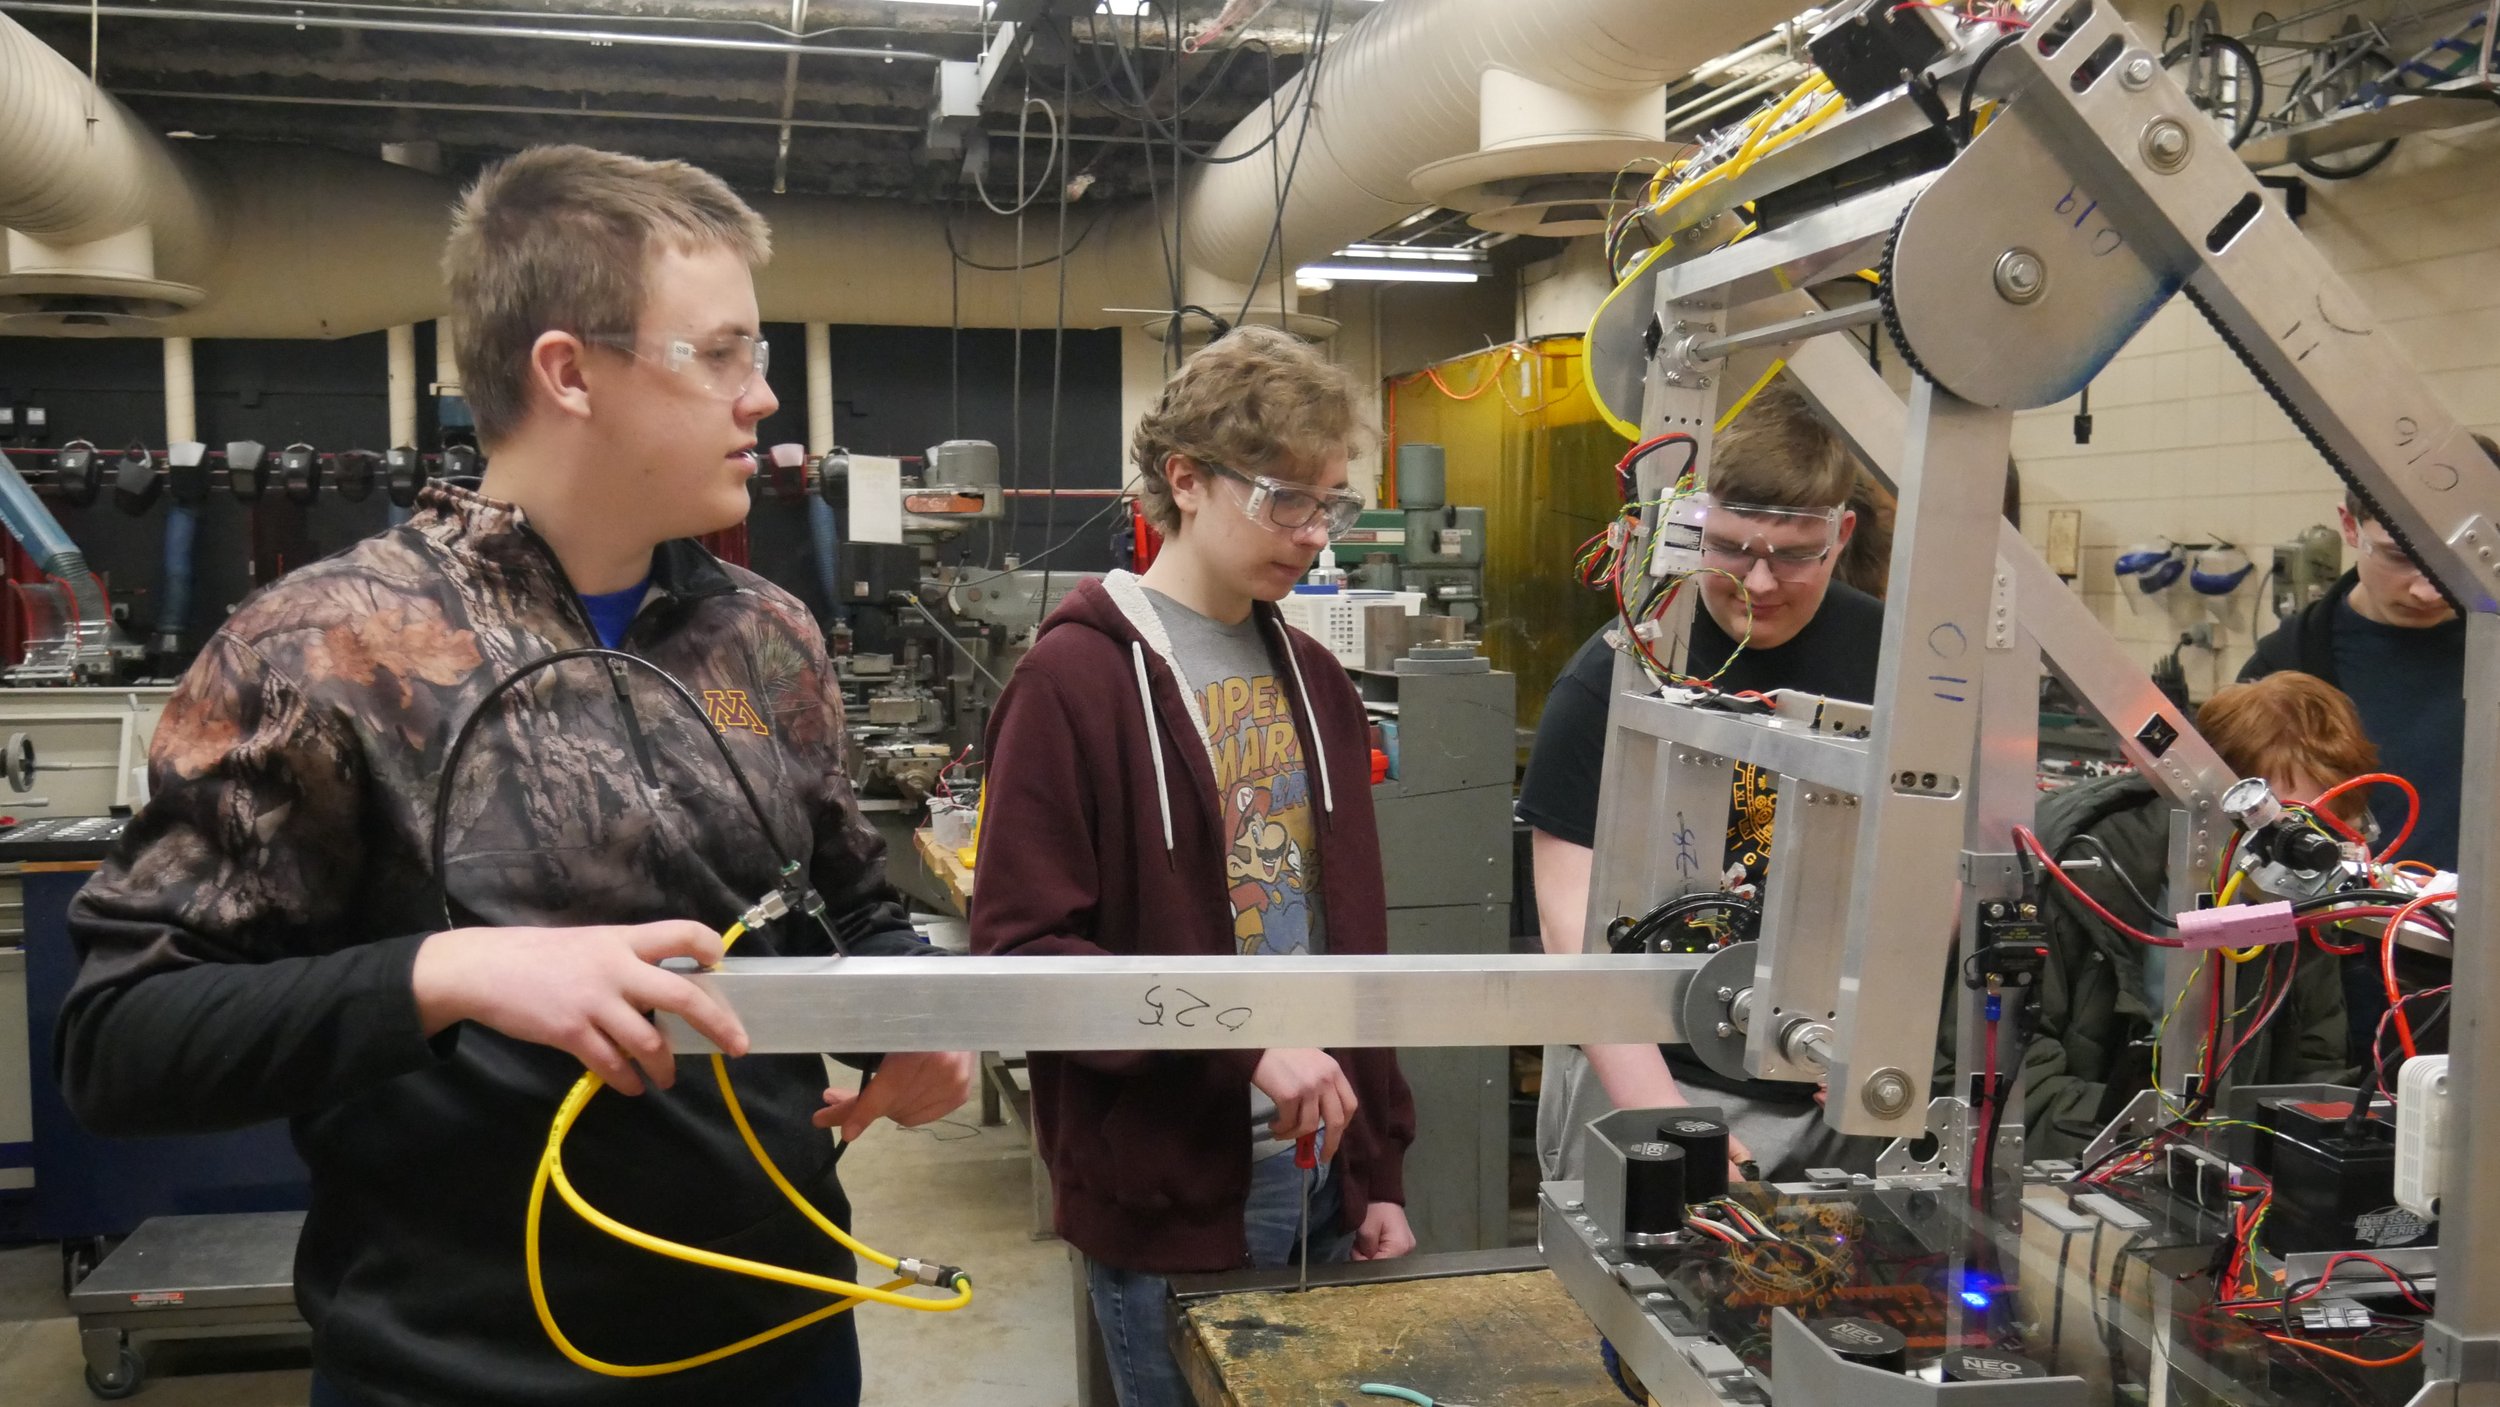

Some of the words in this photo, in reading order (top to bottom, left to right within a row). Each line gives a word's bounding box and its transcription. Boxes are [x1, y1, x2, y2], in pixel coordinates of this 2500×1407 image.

[1195, 675, 1290, 738] UPE
[1829, 1323, 1884, 1344] NEO
[1962, 1357, 2022, 1372] NEO
